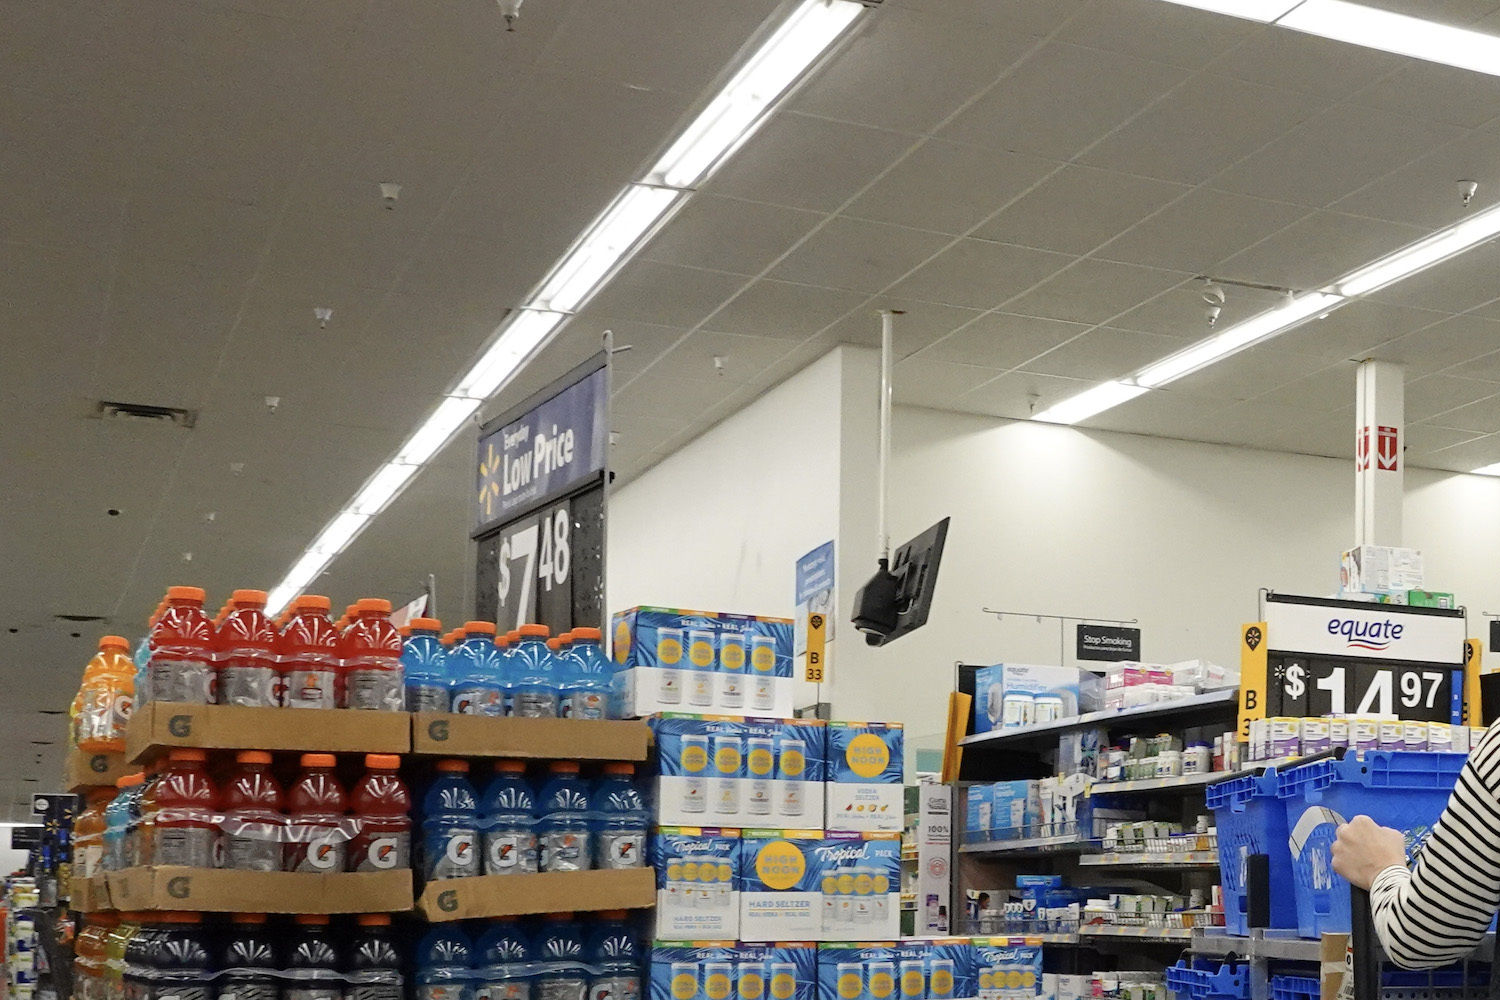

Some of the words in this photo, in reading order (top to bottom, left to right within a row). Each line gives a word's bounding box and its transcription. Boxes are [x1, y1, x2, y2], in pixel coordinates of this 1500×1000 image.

[503, 451, 533, 496] Low
[534, 424, 574, 479] Price
[1328, 619, 1403, 642] equate
[1083, 635, 1101, 645] Stop
[1102, 636, 1131, 647] Smoking
[811, 653, 819, 664] B
[807, 669, 822, 680] 33
[1246, 690, 1257, 710] B
[672, 841, 713, 854] Tropical
[815, 843, 870, 863] Tropical
[875, 849, 893, 857] PACK
[764, 855, 797, 864] HIGH
[762, 865, 800, 874] NOON
